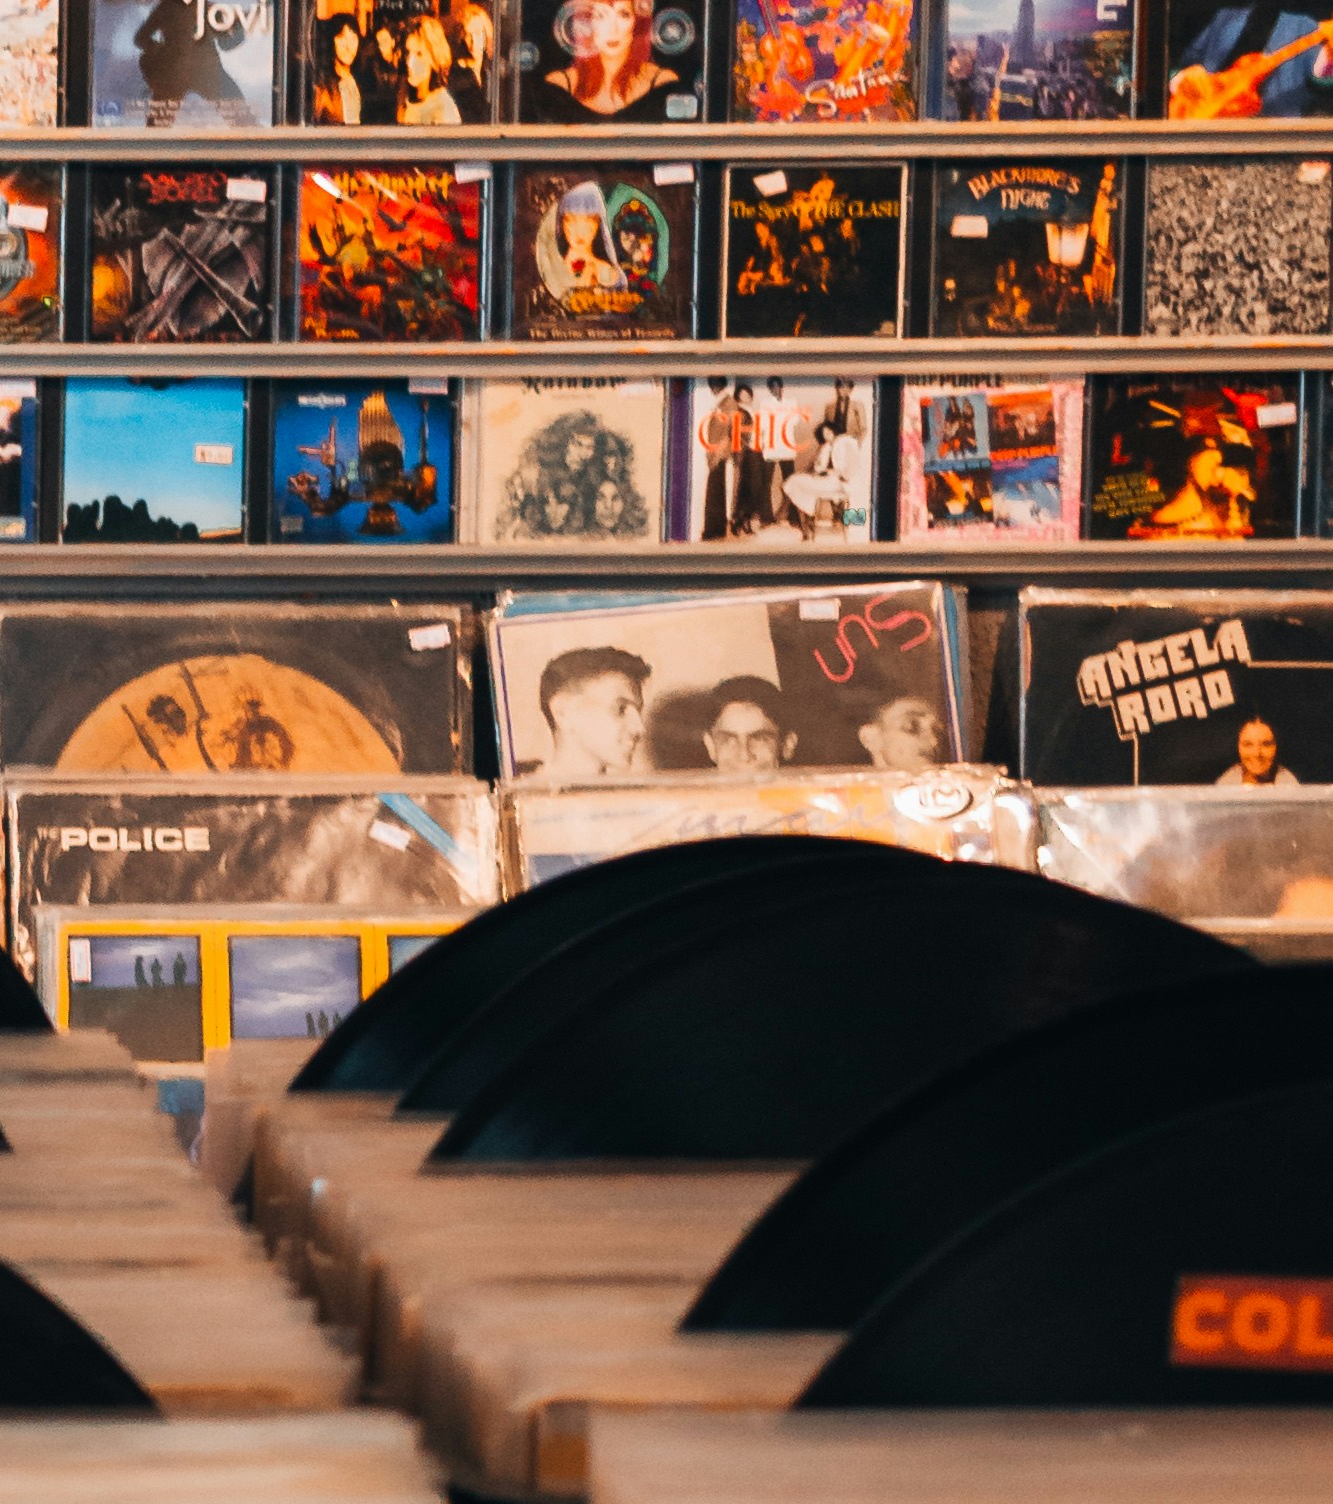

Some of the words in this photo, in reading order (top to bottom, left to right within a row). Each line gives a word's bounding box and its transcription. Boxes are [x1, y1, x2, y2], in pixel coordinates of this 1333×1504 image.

[698, 408, 812, 453] CHIC
[1075, 618, 1252, 706] ANGELA
[1111, 669, 1236, 742] RORO
[61, 826, 211, 853] POLICE
